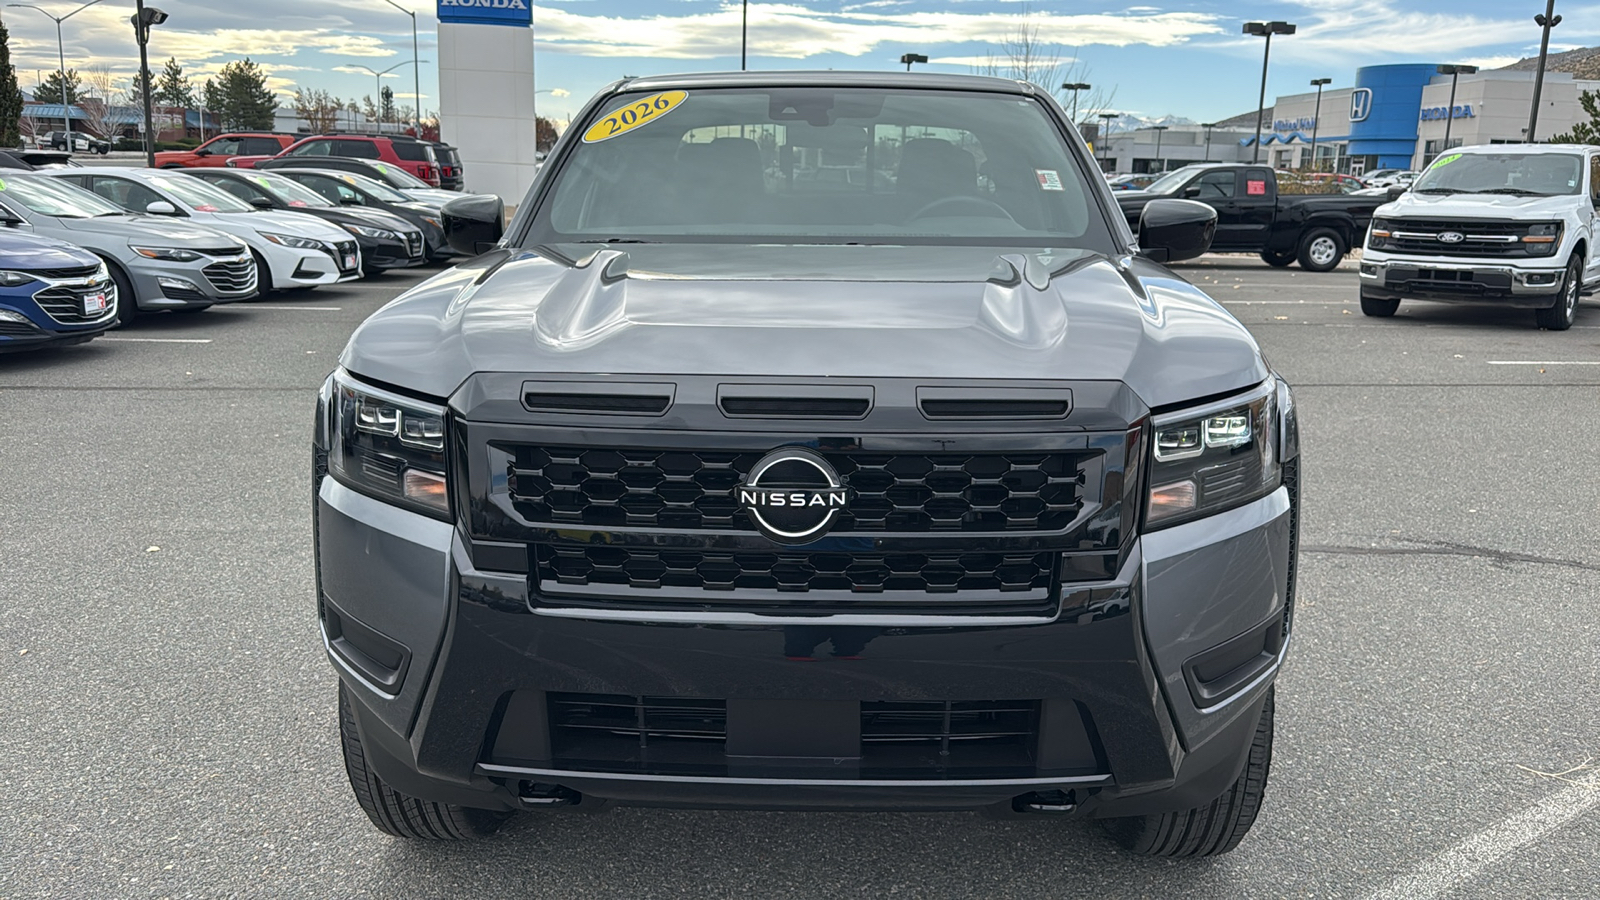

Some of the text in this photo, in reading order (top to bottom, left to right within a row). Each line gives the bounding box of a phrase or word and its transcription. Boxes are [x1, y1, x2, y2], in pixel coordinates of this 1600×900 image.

[603, 94, 670, 135] 2026
[1421, 105, 1476, 121] HONDA
[741, 490, 846, 507] NISSAN
